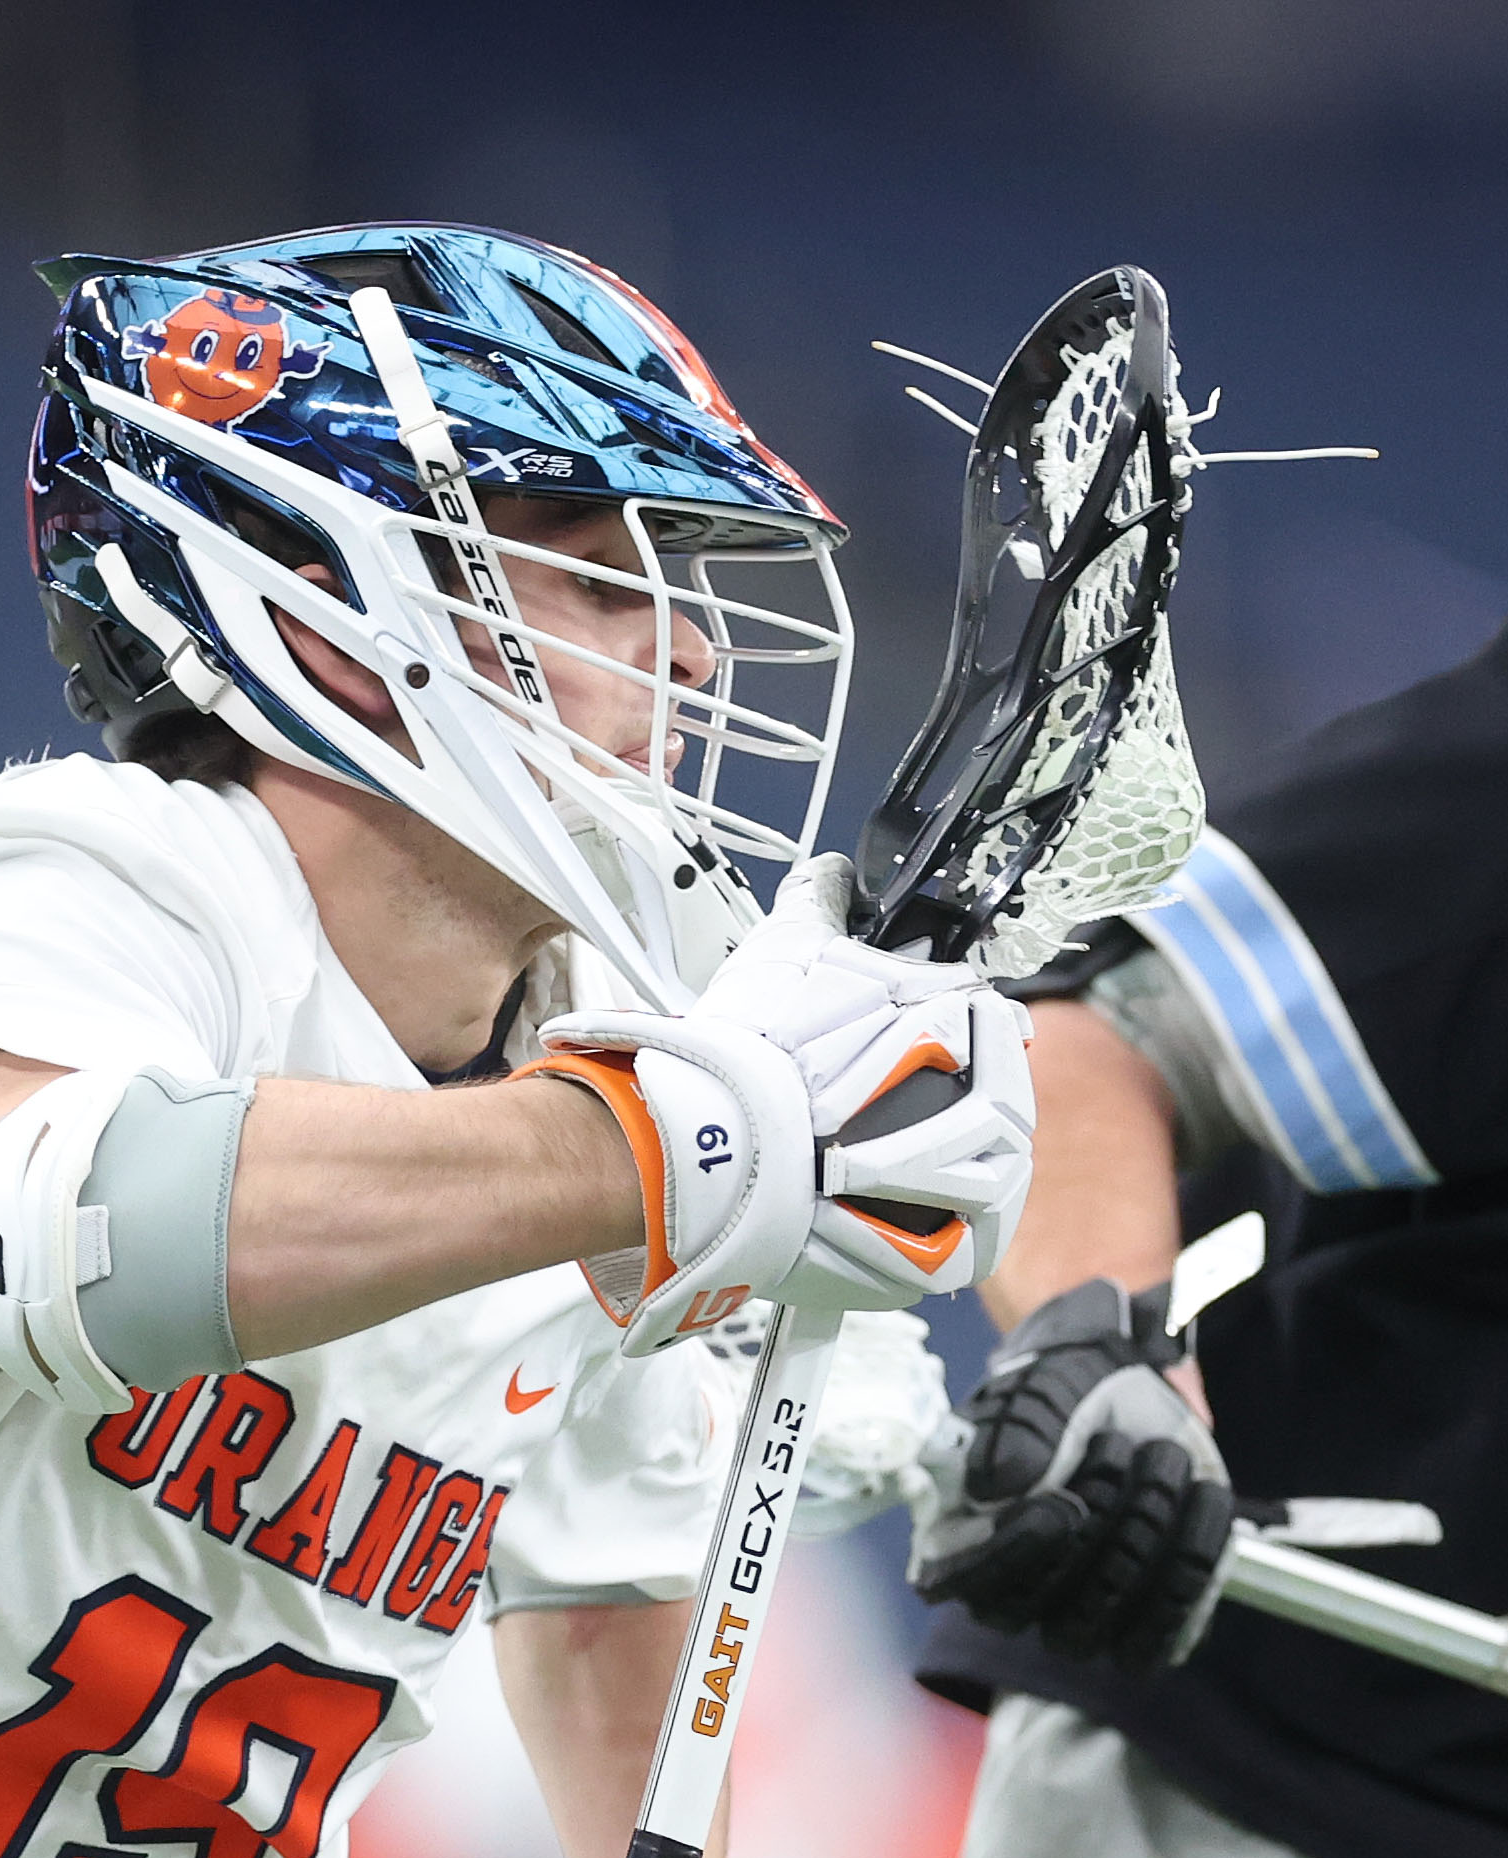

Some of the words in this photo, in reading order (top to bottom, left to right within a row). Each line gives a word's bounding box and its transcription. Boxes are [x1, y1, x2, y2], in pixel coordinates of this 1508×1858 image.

[520, 466, 574, 478] PRO
[696, 1124, 732, 1174] 19
[85, 1369, 509, 1636] ORANGE
[691, 1602, 750, 1738] GAIT
[730, 1482, 784, 1594] GCX
[762, 1398, 807, 1474] 5.2
